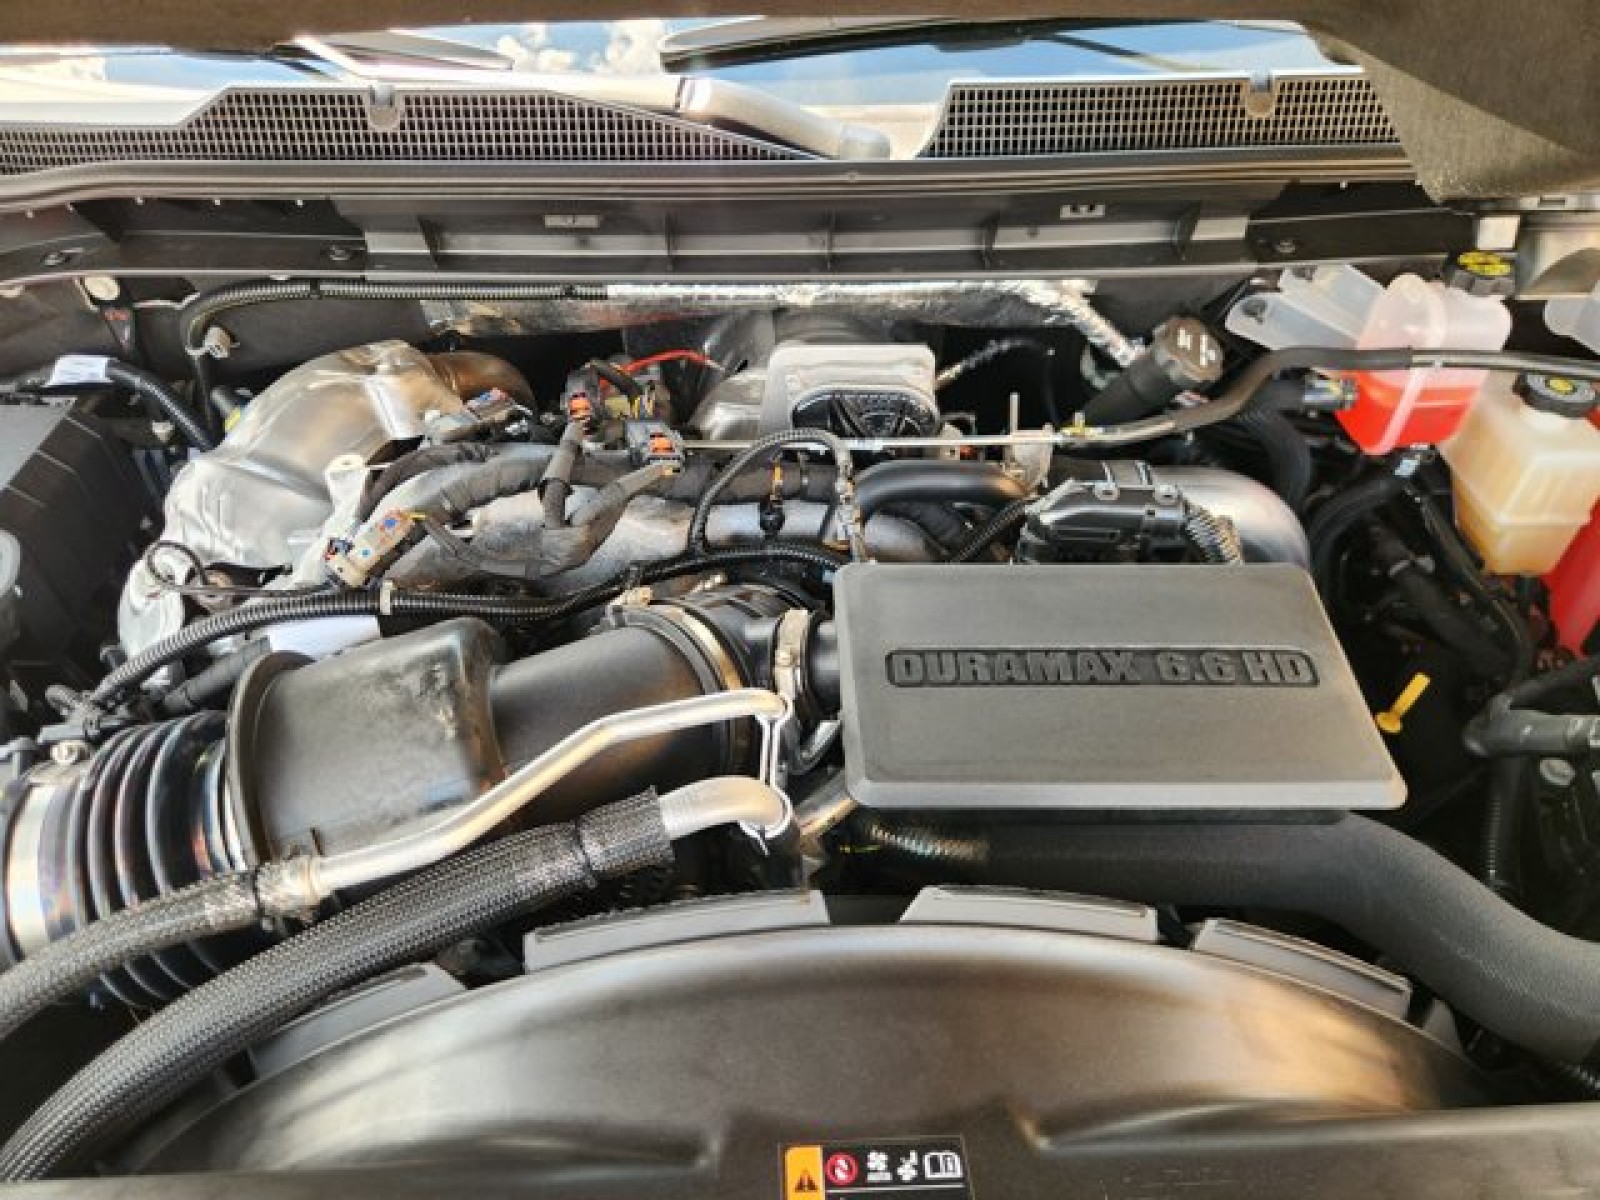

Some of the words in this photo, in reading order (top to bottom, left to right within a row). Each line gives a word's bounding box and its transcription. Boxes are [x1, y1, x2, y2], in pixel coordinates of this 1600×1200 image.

[893, 651, 1139, 684] DURAMAX
[1157, 652, 1236, 683] 6.6
[1241, 652, 1315, 684] HD
